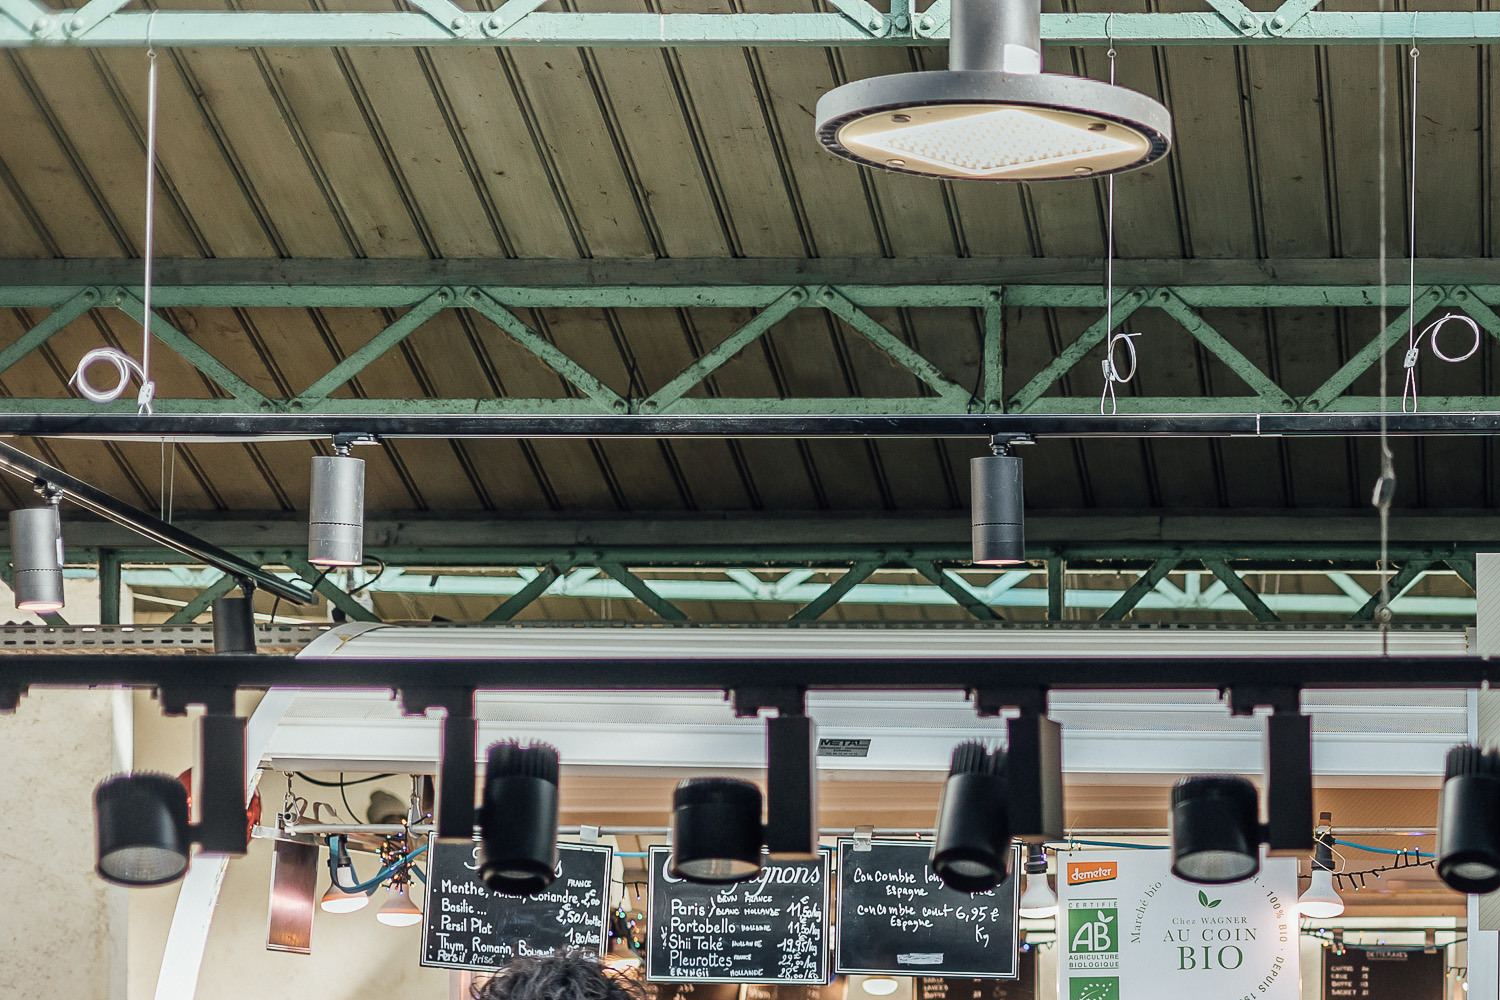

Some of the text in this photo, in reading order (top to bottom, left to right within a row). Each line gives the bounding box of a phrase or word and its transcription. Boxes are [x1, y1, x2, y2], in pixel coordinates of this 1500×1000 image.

[1071, 867, 1112, 881] demeter
[441, 879, 489, 899] Menthe,
[885, 885, 928, 902] Espagne
[441, 898, 474, 914] Basilic
[671, 899, 706, 916] Paris
[1131, 881, 1163, 944] Marché bio
[1266, 890, 1285, 920] 100%
[441, 915, 467, 932] Persil
[471, 917, 493, 935] Plat
[670, 917, 736, 934] Portobello
[890, 915, 934, 932] Espagne
[1172, 917, 1248, 925] Chez WAGNER
[669, 933, 691, 950] Shii
[693, 936, 723, 951] Také
[1071, 921, 1112, 952] AB
[1163, 928, 1257, 942] AU COIN
[1278, 924, 1288, 943] BIO
[436, 932, 467, 954] Thym,
[437, 949, 466, 964] Persil
[669, 950, 733, 967] Pleurottes
[1068, 953, 1119, 961] AGRICULTURE
[1069, 961, 1119, 969] BIOLOGIQUE
[1177, 945, 1243, 971] BIO
[1257, 956, 1285, 994] DEPUIS
